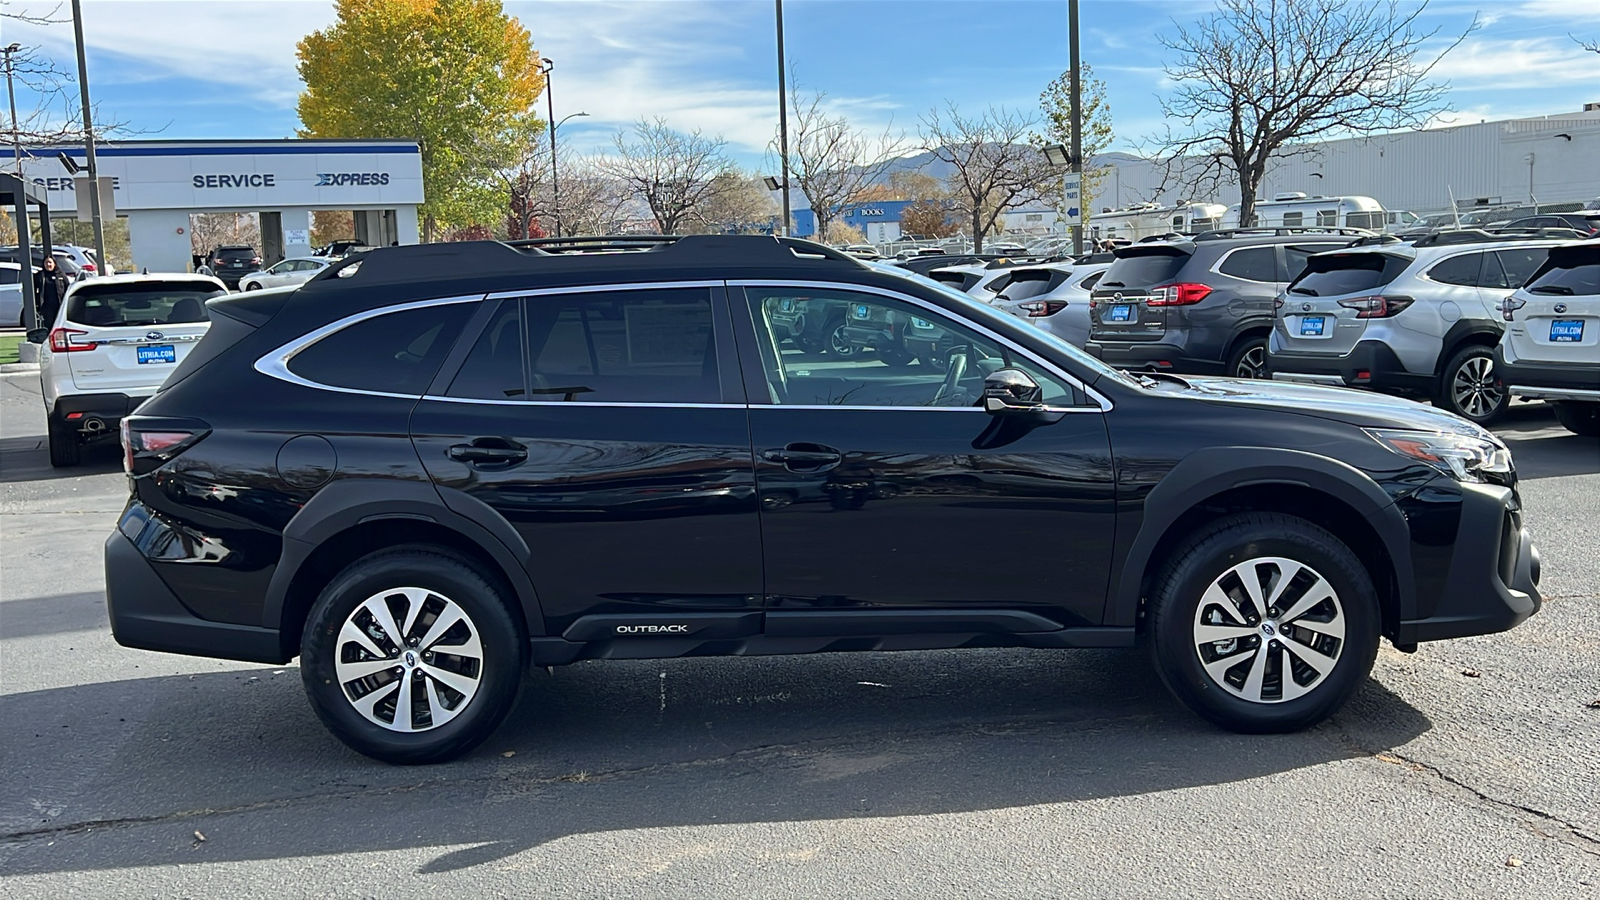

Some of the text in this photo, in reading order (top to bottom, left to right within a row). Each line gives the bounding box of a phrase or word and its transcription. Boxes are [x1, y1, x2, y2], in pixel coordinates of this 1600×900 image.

[33, 177, 120, 191] SERE
[192, 174, 276, 188] SERVICE
[314, 172, 390, 187] EXPRESS
[1065, 181, 1080, 190] SERVICE
[1066, 191, 1079, 199] PARTS
[861, 208, 885, 216] BOOKS
[1551, 326, 1582, 335] LITHIA.COM
[138, 350, 174, 359] LITHIA.COM
[616, 624, 688, 633] OUTBACK
